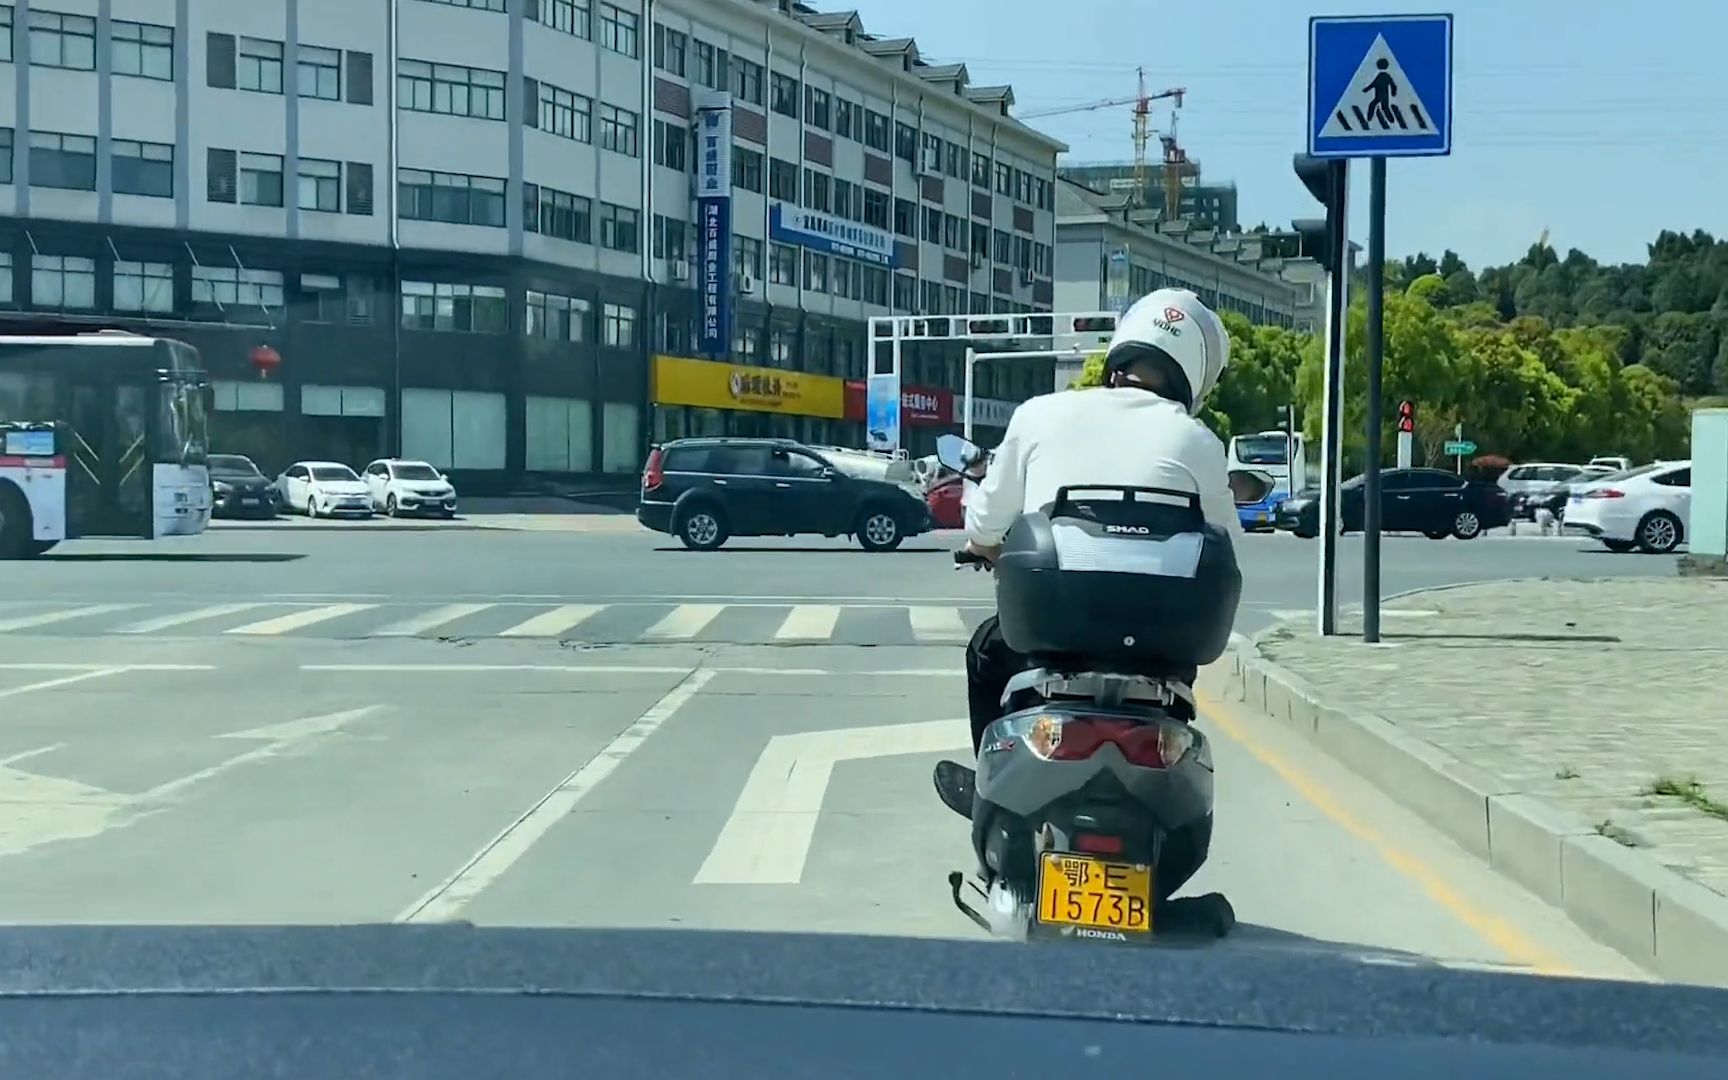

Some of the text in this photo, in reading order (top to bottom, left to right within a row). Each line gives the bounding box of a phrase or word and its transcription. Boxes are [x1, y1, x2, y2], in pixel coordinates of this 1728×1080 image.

[1106, 525, 1150, 535] SHAD
[1051, 889, 1145, 927] 1573B
[1076, 928, 1127, 941] HONDA
